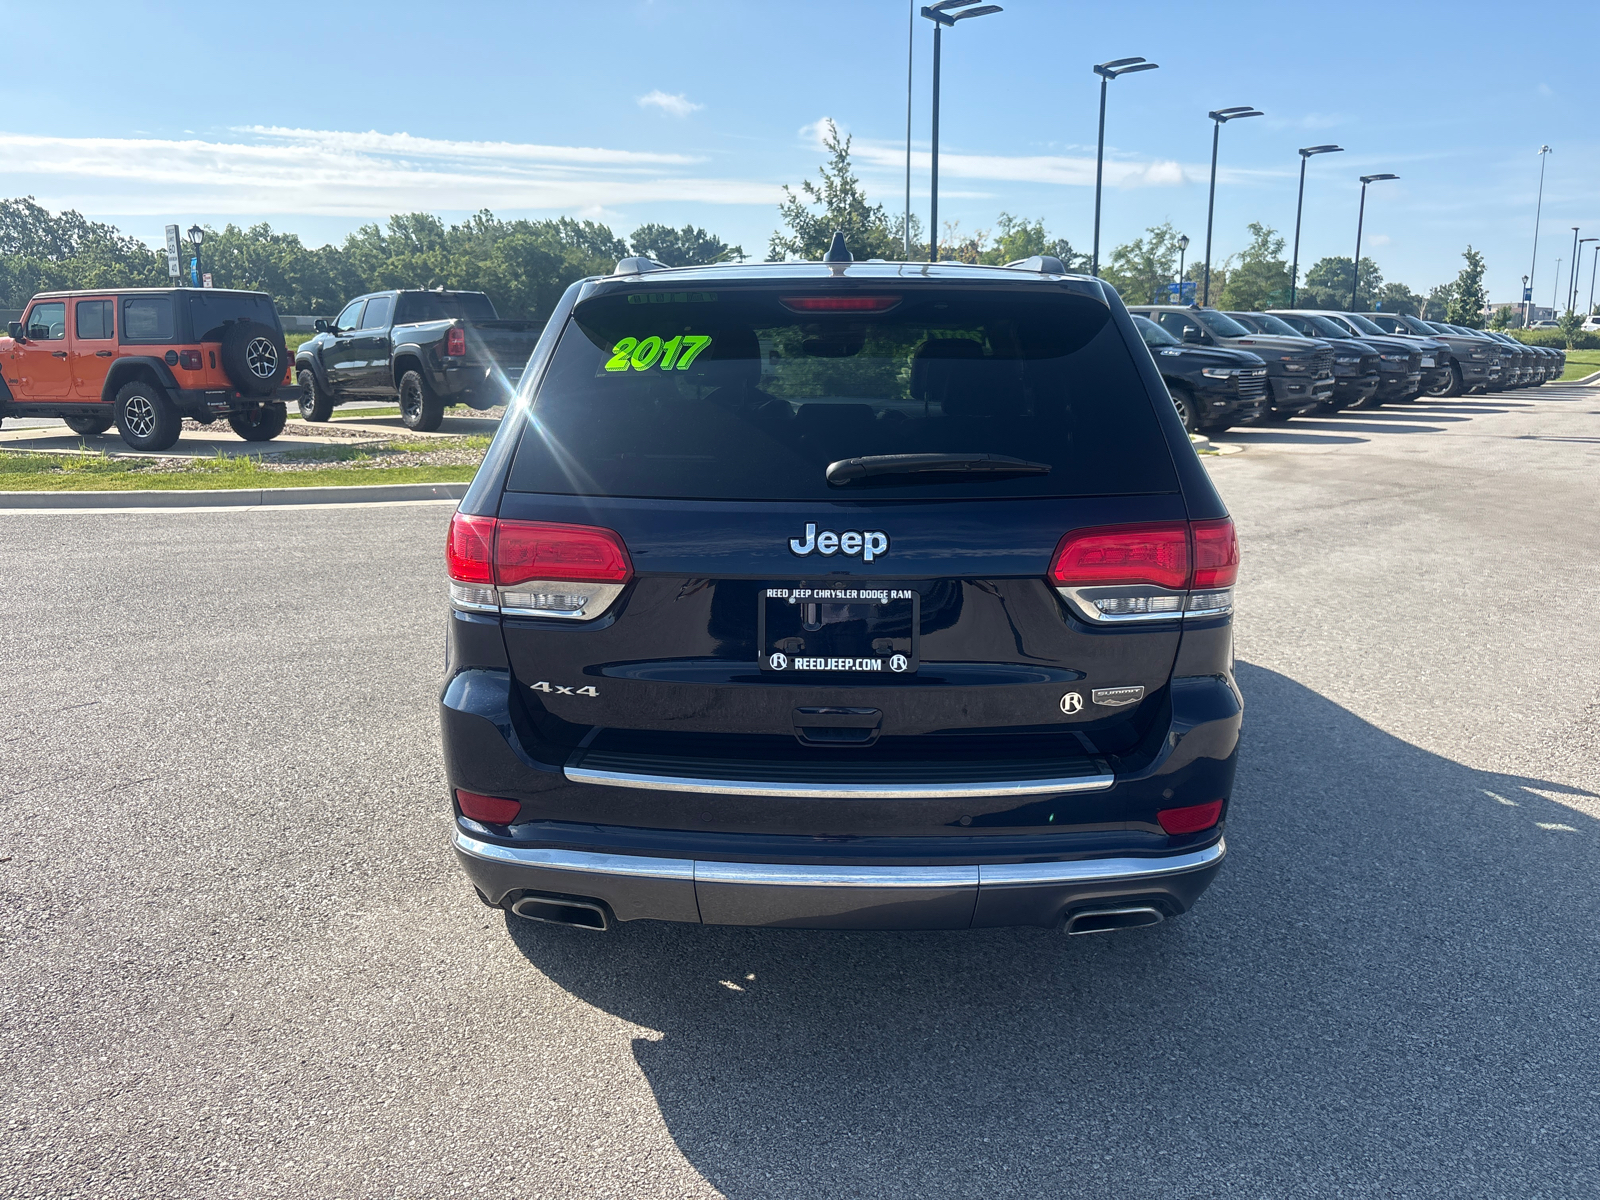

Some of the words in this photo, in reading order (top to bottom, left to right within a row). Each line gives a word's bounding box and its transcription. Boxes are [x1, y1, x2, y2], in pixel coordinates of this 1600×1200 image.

[604, 335, 713, 372] 2017
[789, 522, 890, 563] Jeep
[766, 589, 789, 598] REED
[790, 589, 812, 598] JEEP
[813, 589, 858, 599] CHRYSLER
[859, 590, 889, 599] DODGE
[891, 590, 912, 599] RAM
[794, 657, 882, 671] REEDJEEP.COM
[529, 681, 601, 698] 4x4
[1097, 688, 1141, 697] SUMMIT
